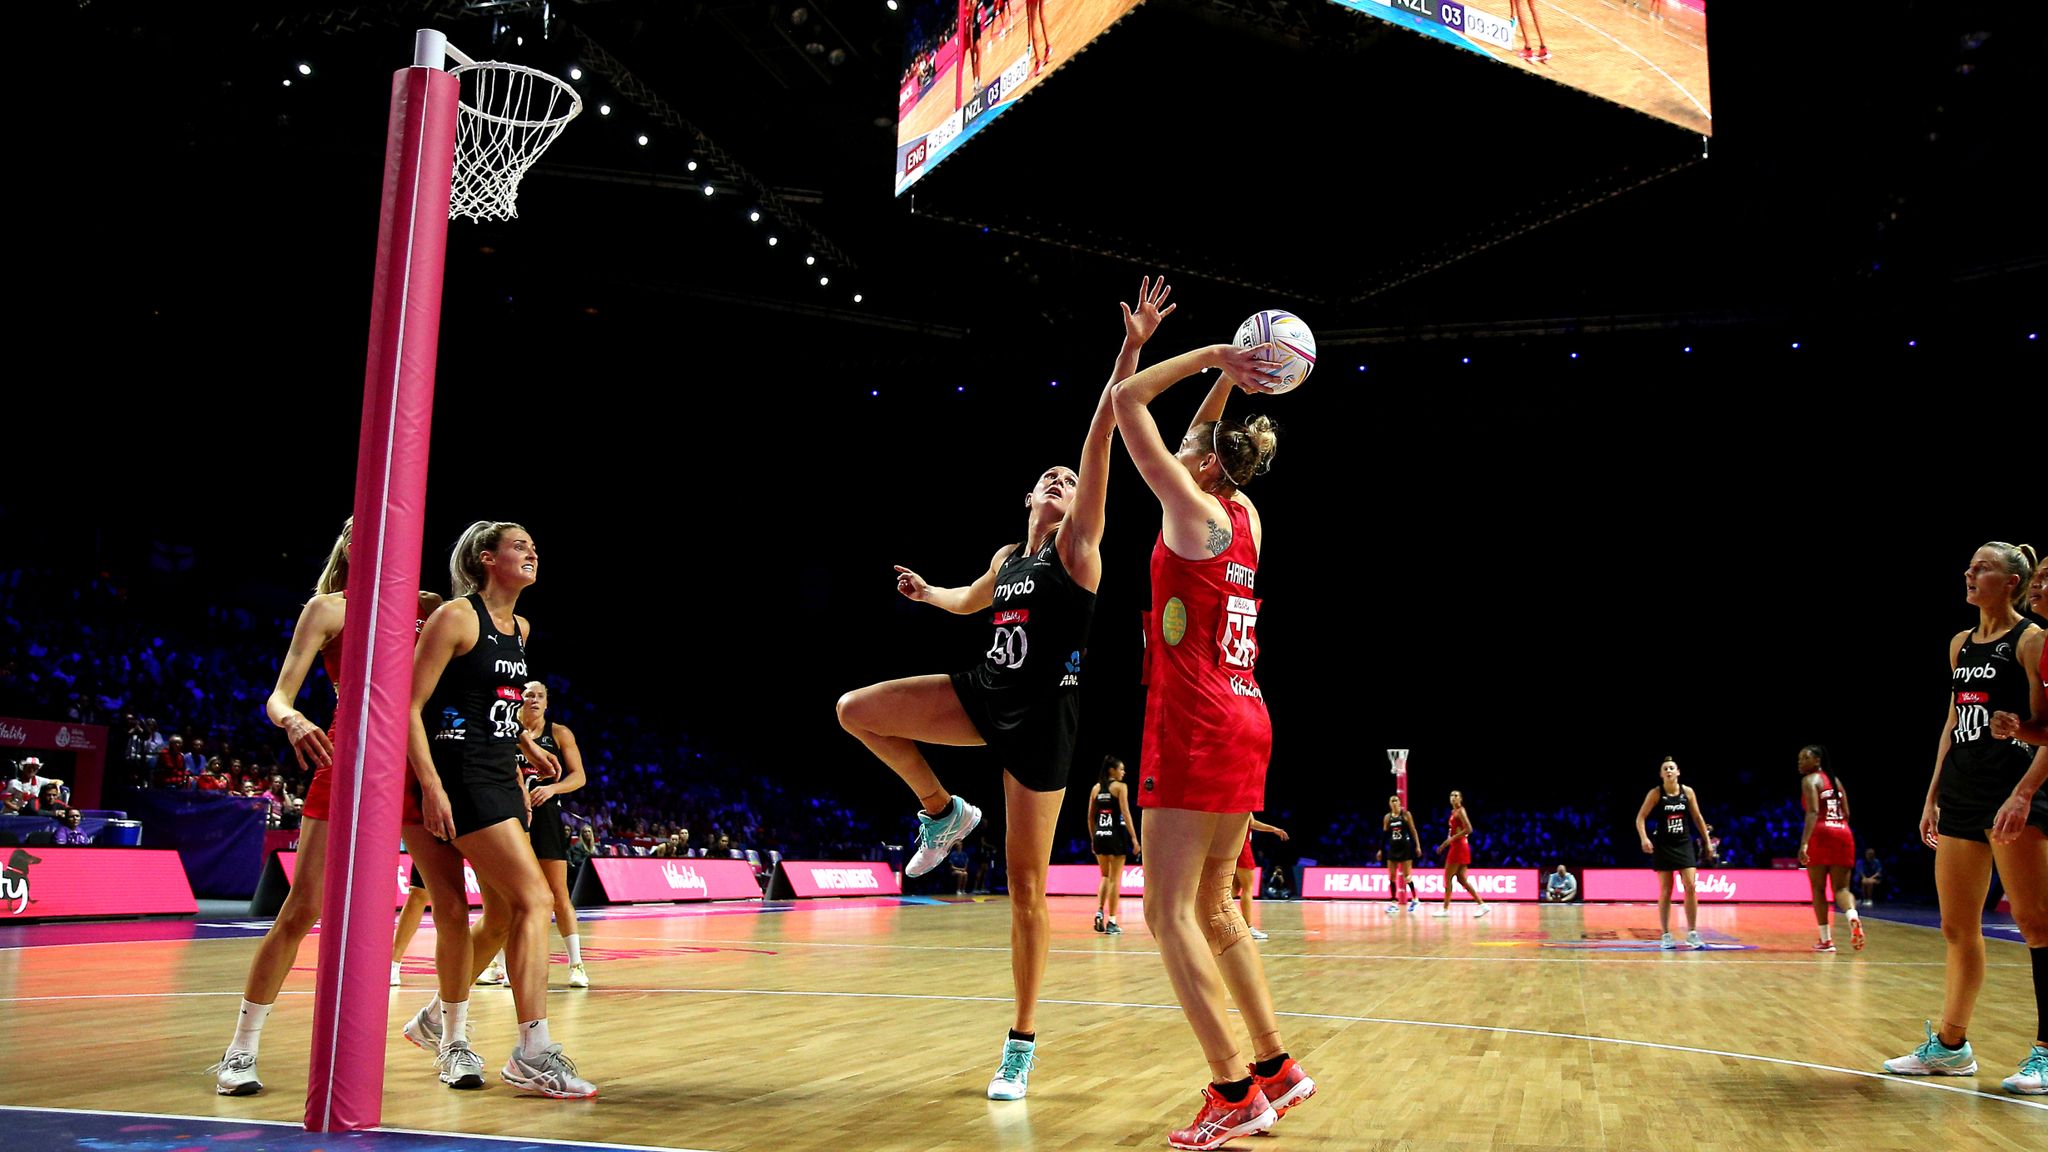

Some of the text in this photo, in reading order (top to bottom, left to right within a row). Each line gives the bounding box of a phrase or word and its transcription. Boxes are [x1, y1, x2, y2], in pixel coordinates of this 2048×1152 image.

[1441, 4, 1462, 25] Q3
[1467, 14, 1509, 43] 09:20
[907, 144, 925, 171] ENG
[965, 98, 983, 123] NZL
[987, 82, 1000, 106] Q3
[1001, 61, 1026, 92] 09:20
[994, 575, 1035, 601] myob
[1225, 561, 1255, 590] HARTE
[1953, 662, 1996, 683] myob
[1664, 802, 1686, 811] myob
[1099, 813, 1113, 828] GA
[661, 860, 708, 897] Vitality
